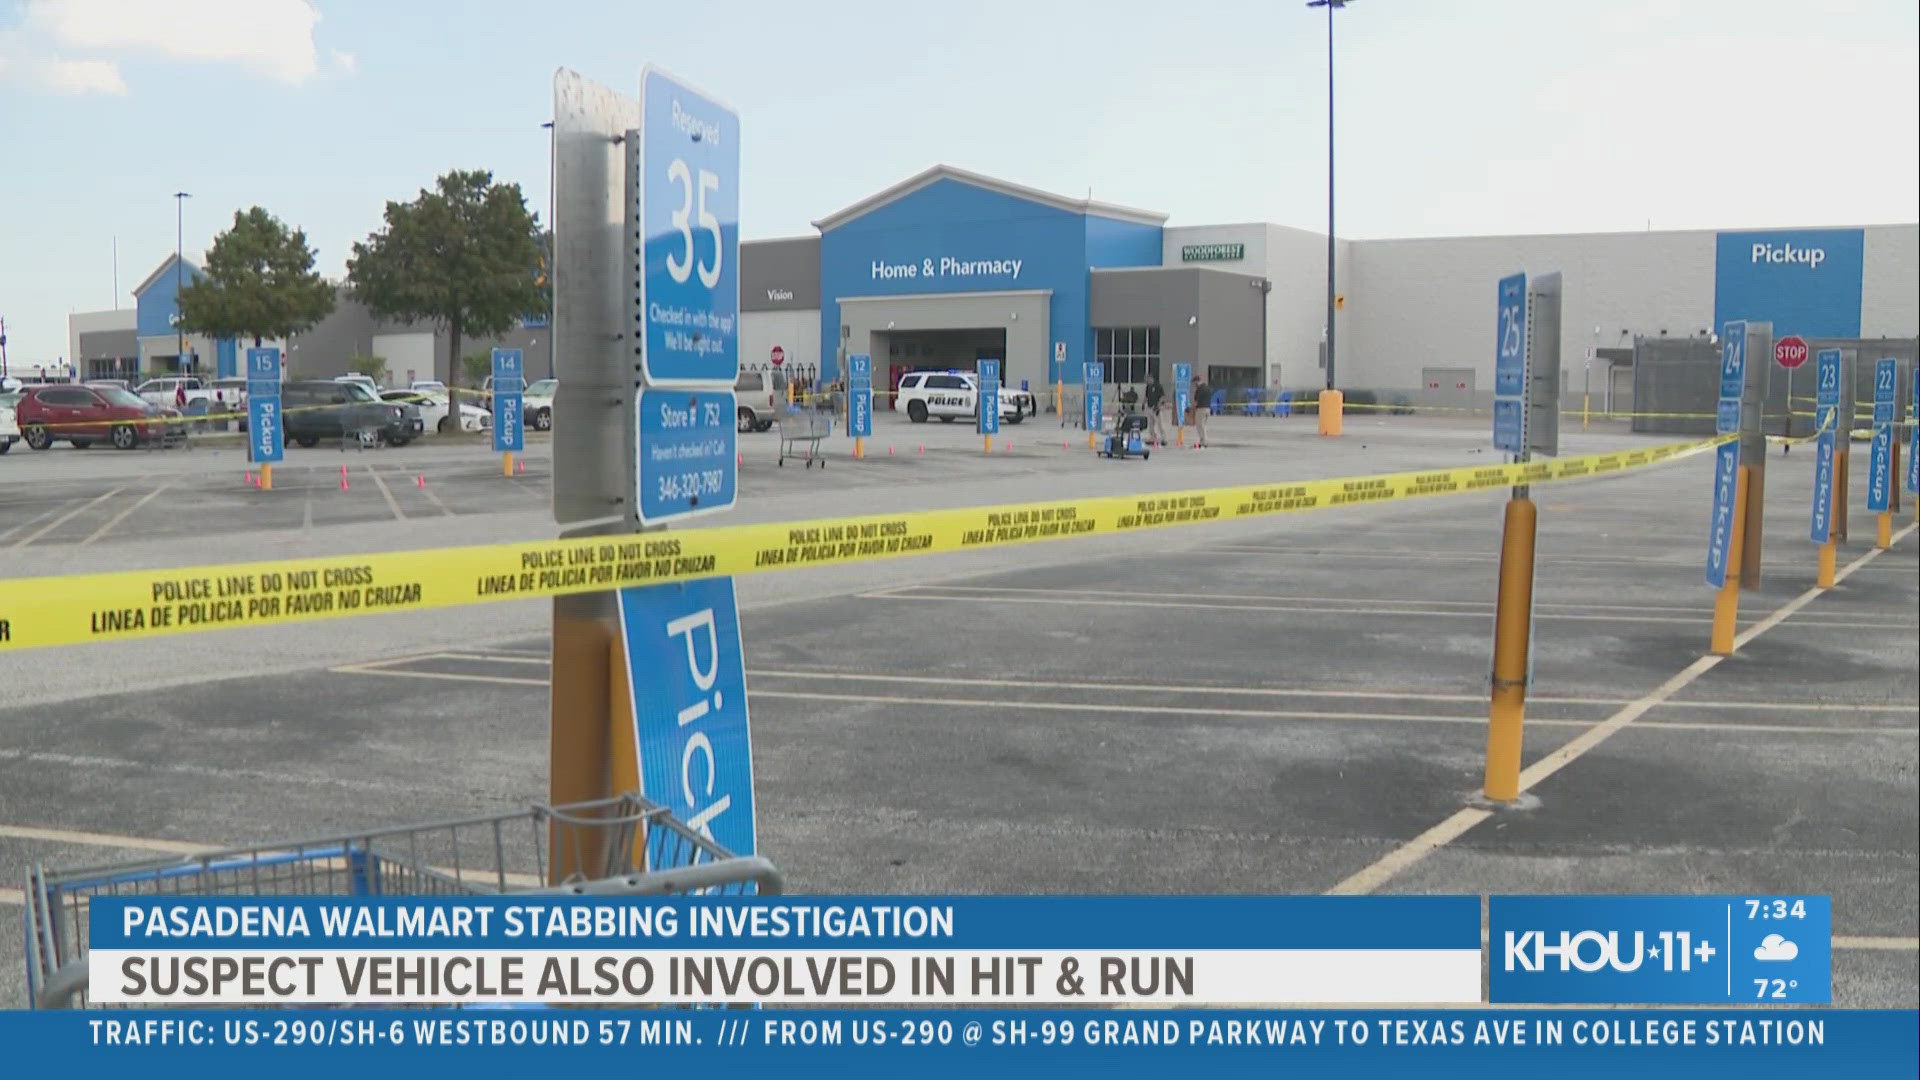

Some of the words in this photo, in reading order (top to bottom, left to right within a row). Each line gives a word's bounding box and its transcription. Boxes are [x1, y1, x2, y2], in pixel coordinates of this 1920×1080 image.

[672, 99, 720, 145] Reserved
[666, 158, 722, 288] 35
[872, 260, 917, 279] Home
[922, 257, 935, 277] &
[941, 257, 1022, 279] Pharmacy
[1752, 243, 1825, 268] Pickup
[767, 289, 794, 301] Vision
[1502, 305, 1520, 357] 25
[256, 355, 273, 371] 15
[500, 356, 515, 370] 14
[855, 360, 866, 372] 12
[1726, 341, 1741, 374] 24
[1776, 346, 1806, 360] STOP
[985, 365, 994, 376] 11
[1089, 367, 1100, 377] 10
[1821, 363, 1836, 389] 23
[1879, 369, 1892, 390] 22
[661, 403, 688, 428] Store
[704, 403, 720, 426] 752
[854, 393, 867, 432] Pickup
[927, 395, 964, 406] POLICE
[260, 402, 276, 456] Pickup
[501, 398, 517, 445] Pickup
[1872, 433, 1888, 503] Pickup
[1815, 444, 1832, 531] Pickup
[1712, 452, 1734, 569] Pickup
[522, 549, 564, 569] POLICE
[568, 546, 595, 565] LINE
[599, 544, 615, 562] DO
[618, 543, 641, 560] NOT
[645, 539, 681, 558] CROSS
[153, 578, 211, 602] POLICE
[218, 575, 255, 597] LINE
[261, 572, 282, 593] DO
[287, 570, 318, 590] NOT
[324, 565, 373, 588] CROSS
[478, 574, 515, 595] LINEA
[520, 573, 534, 591] DE
[539, 567, 586, 590] POLICIA
[590, 565, 613, 584] POR
[616, 560, 652, 580] FAVOR
[655, 559, 672, 577] NO
[674, 554, 716, 575] CRUZAR
[91, 608, 145, 633] LINEA
[151, 605, 171, 628] DE
[178, 599, 243, 626] POLICIA
[249, 596, 280, 619] POR
[286, 591, 333, 615] FAVOR
[338, 588, 361, 610] NO
[365, 583, 421, 607] CRUZAR
[667, 608, 730, 866] Pick
